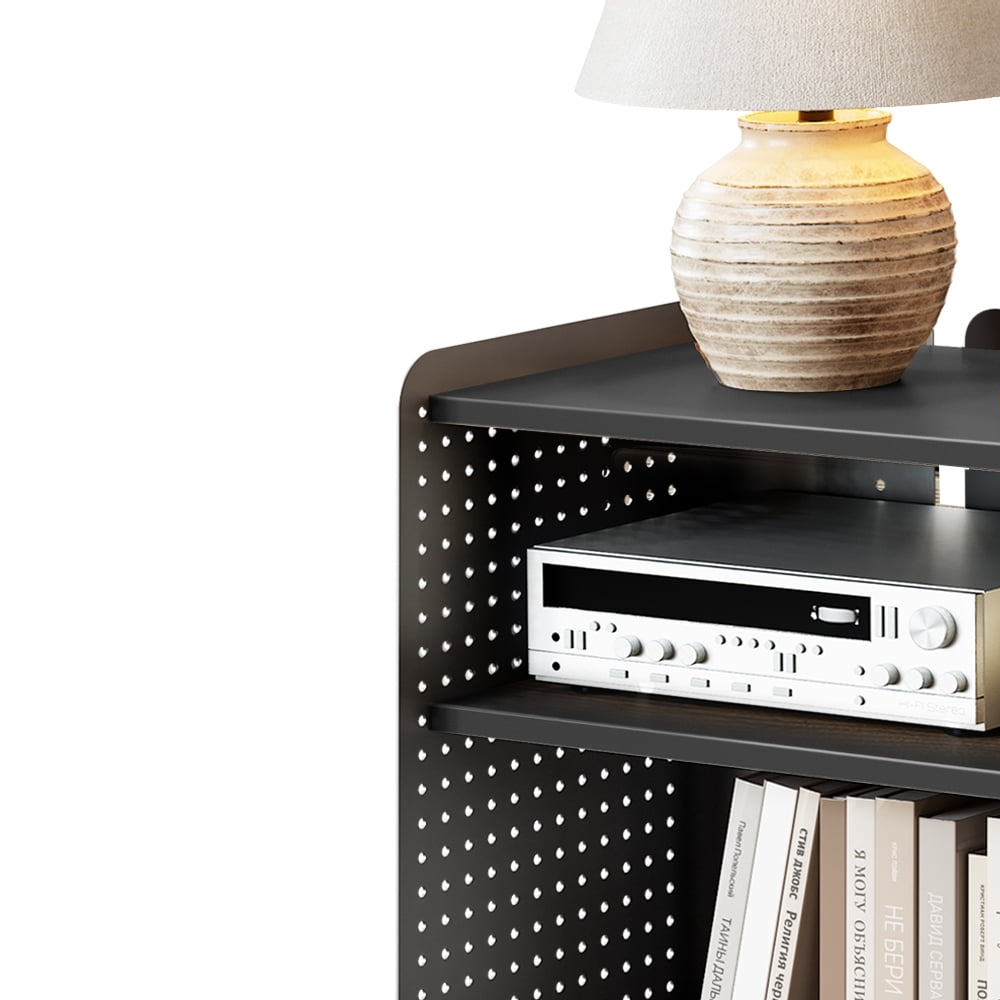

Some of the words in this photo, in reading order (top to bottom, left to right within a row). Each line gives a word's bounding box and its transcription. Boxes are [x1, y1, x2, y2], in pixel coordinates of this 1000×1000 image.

[854, 849, 866, 860] Я
[854, 864, 866, 912] МОГУ
[777, 911, 797, 969] Религия
[883, 904, 903, 936] НЕ
[927, 892, 944, 946] ДАВИД
[883, 938, 904, 995] БЕРИ
